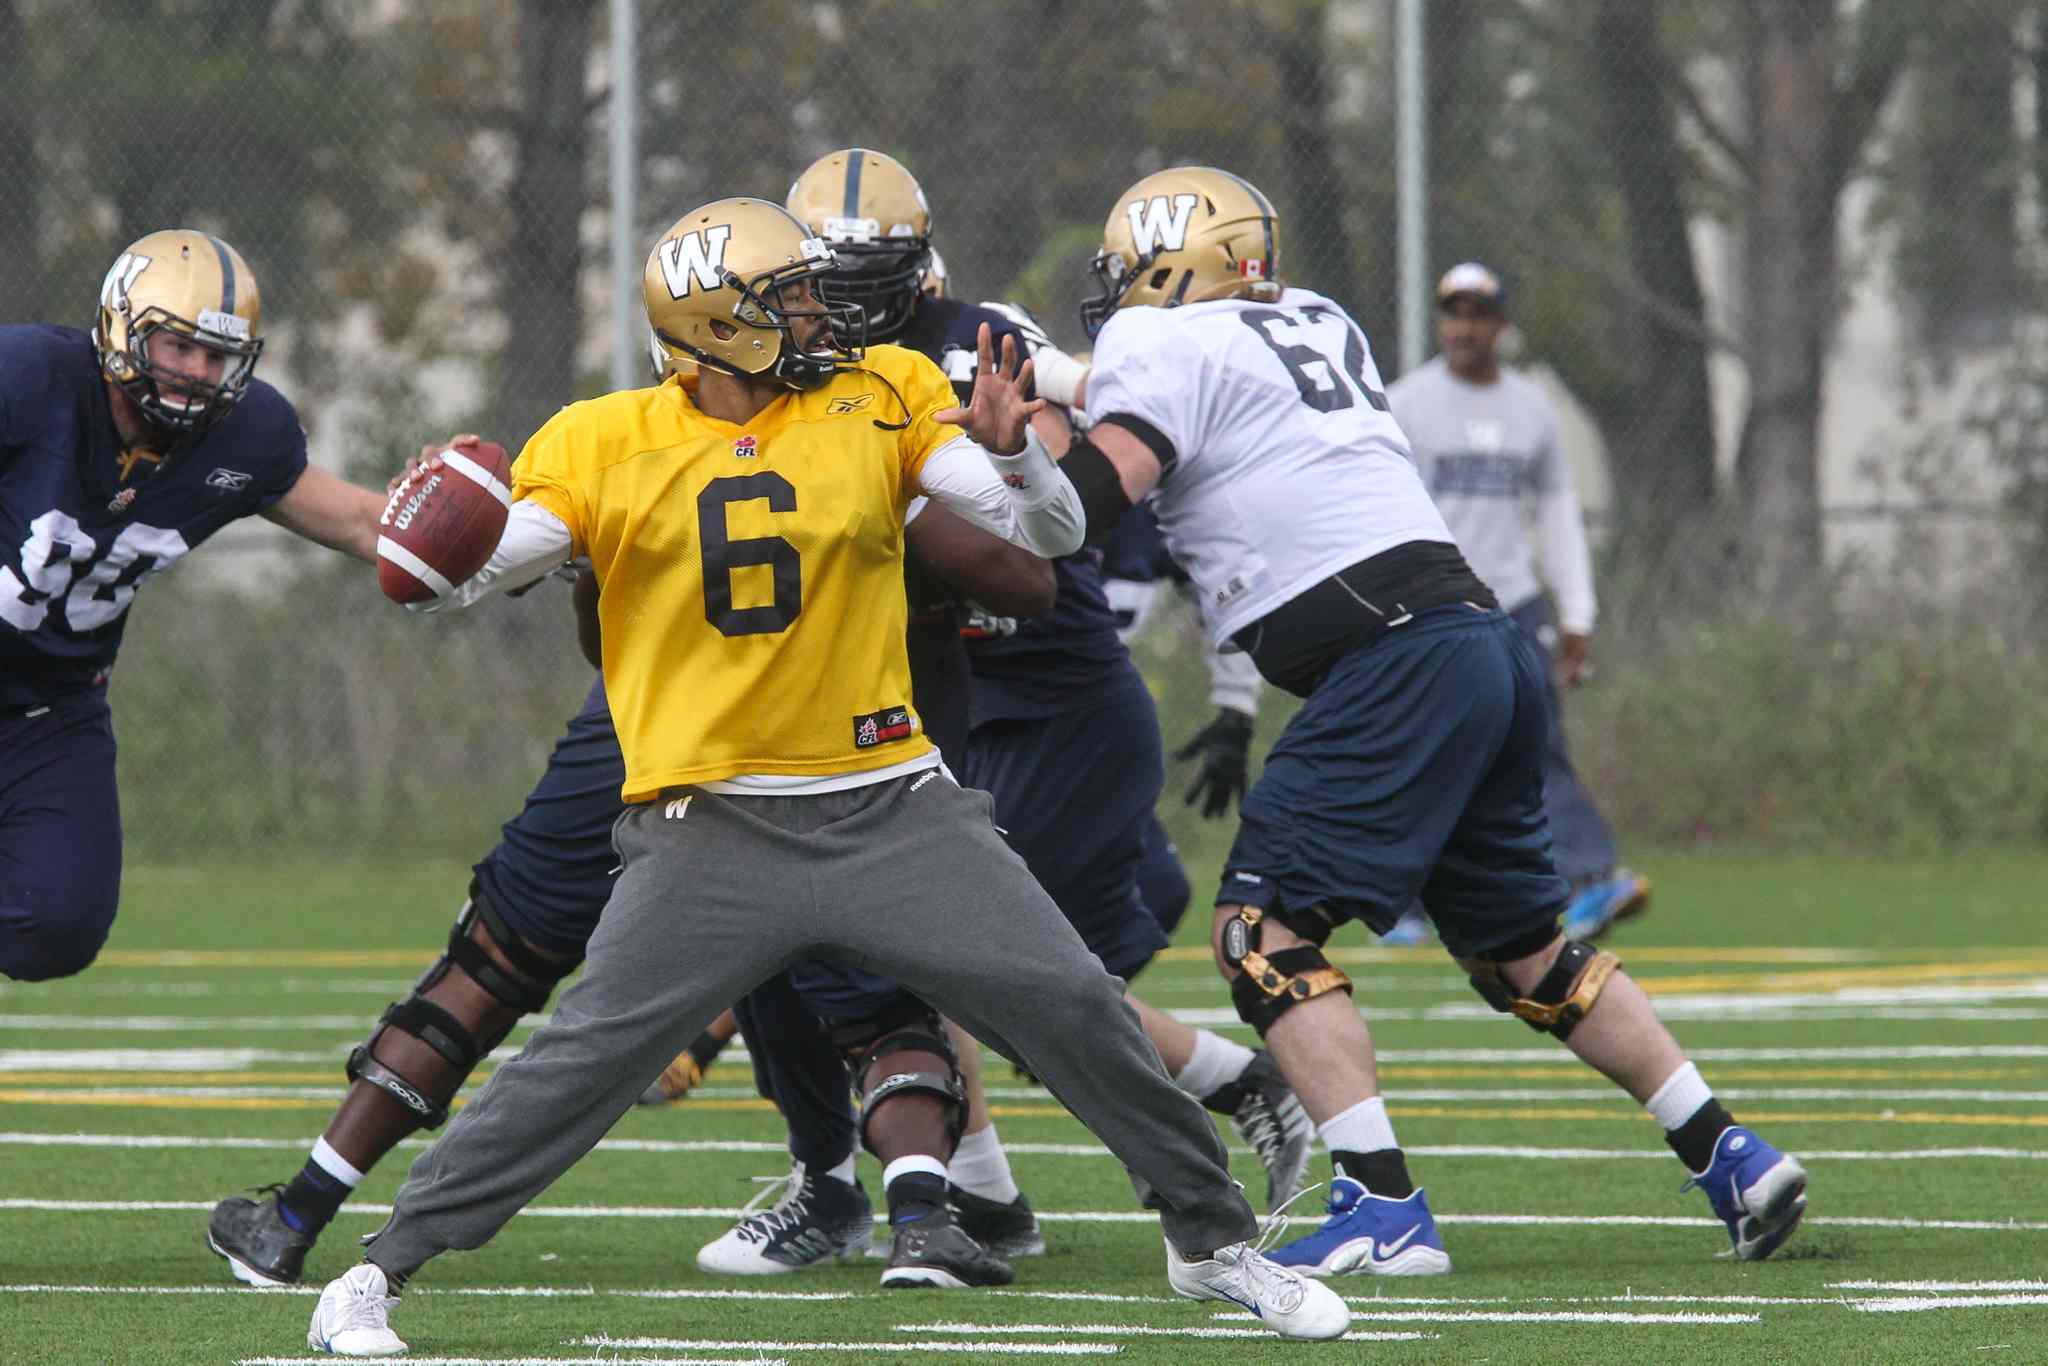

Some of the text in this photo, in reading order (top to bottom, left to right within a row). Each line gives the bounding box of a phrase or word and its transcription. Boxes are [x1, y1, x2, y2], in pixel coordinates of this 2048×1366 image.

[1126, 193, 1198, 257] W
[658, 223, 732, 301] W
[1239, 305, 1392, 414] 62
[735, 447, 756, 458] CFL
[393, 474, 444, 531] Wilson
[696, 469, 802, 638] 6
[857, 731, 880, 747] CFL
[665, 795, 694, 820] W
